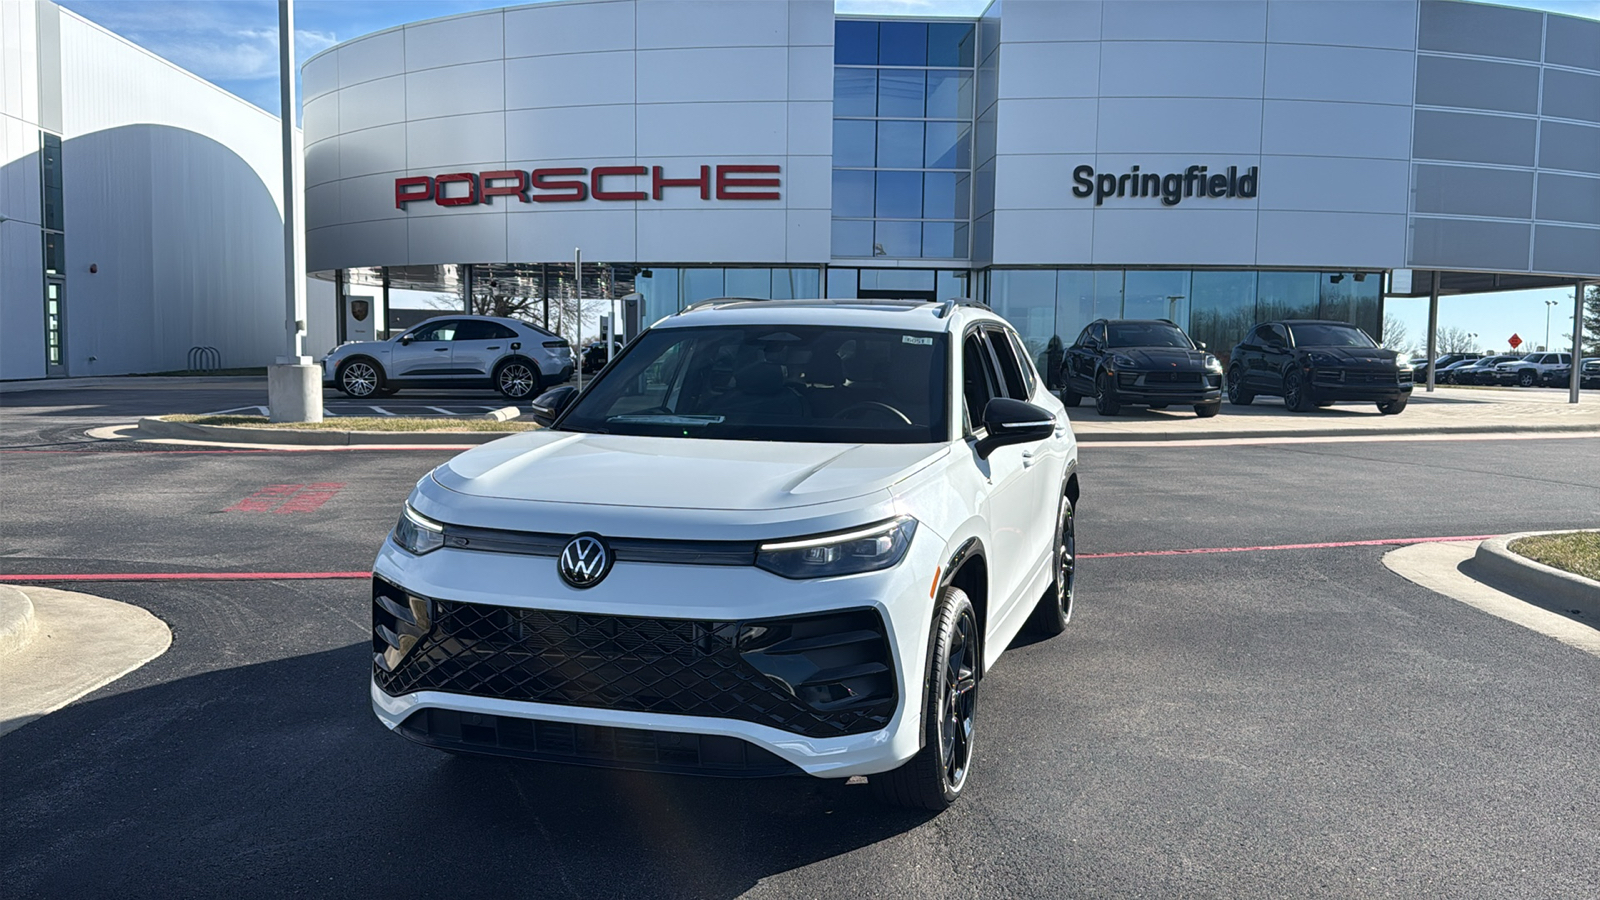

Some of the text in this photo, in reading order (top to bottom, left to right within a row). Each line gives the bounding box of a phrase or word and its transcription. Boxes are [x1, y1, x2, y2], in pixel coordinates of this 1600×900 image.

[395, 164, 781, 210] PORSCHE
[1072, 164, 1259, 206] Springfield
[560, 536, 606, 584] VW
